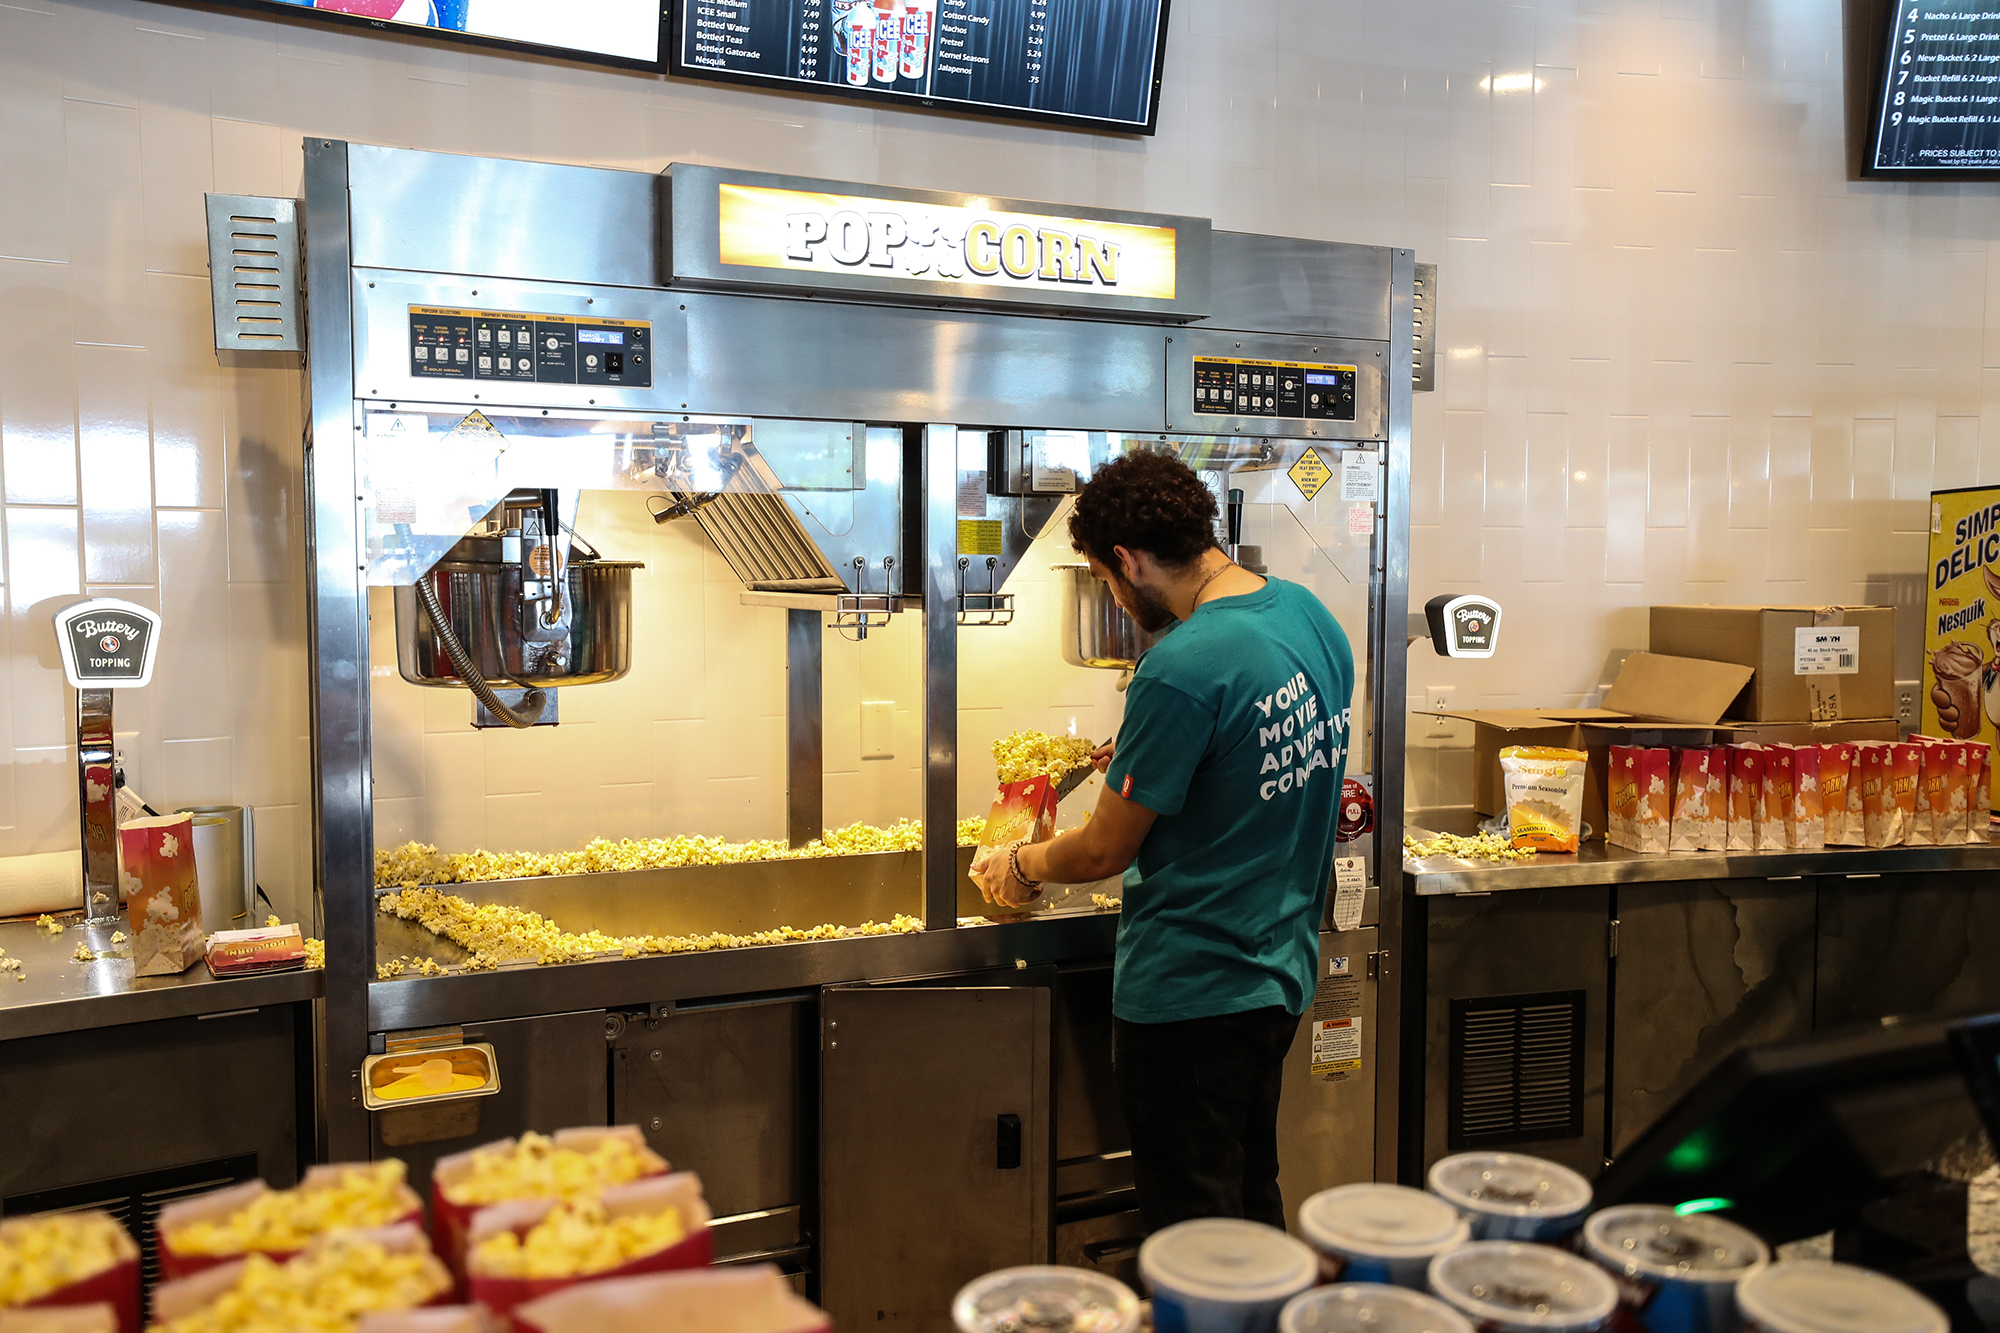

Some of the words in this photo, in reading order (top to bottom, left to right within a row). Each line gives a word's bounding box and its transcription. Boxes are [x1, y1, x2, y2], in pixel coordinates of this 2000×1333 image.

[717, 0, 748, 8] Medium
[944, 0, 967, 9] Candy
[698, 7, 715, 16] ICEE
[716, 9, 737, 19] Small
[803, 10, 820, 19] 7.49
[943, 10, 966, 21] Cotton
[968, 14, 990, 26] Candy
[1030, 10, 1046, 20] 4.99
[1907, 8, 1918, 23] 4
[1924, 12, 1950, 20] Nacho
[1951, 12, 1958, 20] &
[1959, 12, 1981, 22] Large
[696, 19, 725, 29] Bottled
[726, 24, 750, 33] Water
[802, 22, 819, 31] 6.99
[876, 19, 901, 40] ICEE
[903, 14, 929, 35] ICEE
[942, 24, 967, 35] Nachos
[1030, 24, 1044, 33] 4.74
[696, 31, 725, 42] Bottled
[726, 35, 743, 45] Teas
[802, 34, 818, 43] 4.49
[849, 31, 872, 49] ICEE
[940, 38, 964, 47] Pretzel
[1028, 36, 1043, 46] 5.24
[1904, 29, 1915, 44] 5
[1956, 34, 1978, 43] Large
[696, 43, 724, 54] Bottled
[725, 48, 761, 59] Gatorade
[801, 46, 818, 55] 4.49
[939, 50, 962, 61] Kernel
[962, 53, 990, 64] Seasons
[1027, 50, 1042, 59] 5.24
[1900, 50, 1912, 65] 6
[1918, 54, 1936, 62] New
[1937, 54, 1963, 62] Bucket
[1964, 54, 1971, 62] &
[1972, 54, 1977, 62] 2
[1978, 54, 2000, 64] Large
[696, 56, 726, 67] Nesquik
[800, 58, 817, 66] 4.49
[938, 64, 972, 76] Jalapenos
[1026, 62, 1041, 72] 1.99
[800, 70, 816, 78] 4.49
[1028, 76, 1040, 84] .75
[1898, 71, 1909, 85] 7
[1976, 75, 1998, 84] Large
[1894, 92, 1906, 106] 8
[1911, 96, 1934, 104] Magic
[1976, 96, 1998, 104] Large
[1891, 112, 1902, 127] 9
[1908, 116, 1931, 124] Magic
[786, 211, 907, 268] POP
[964, 220, 1121, 285] CORN
[1955, 503, 2000, 545] SIMP
[1935, 533, 2000, 590] DELIC
[1456, 609, 1492, 625] Buttery
[1938, 599, 1985, 636] Nesquik
[76, 620, 140, 641] Buttery
[1462, 636, 1486, 644] TOPPING
[90, 658, 131, 668] TOPPING
[1254, 672, 1309, 718] YOUR
[1828, 694, 1837, 718] USA
[1259, 694, 1317, 748] MOVIE
[1260, 707, 1351, 775] ADVENTUR
[1260, 744, 1347, 801] COMAN
[1538, 784, 1568, 795] Seasoning
[1822, 776, 1841, 798] CORN
[992, 806, 1032, 842] POPCORN
